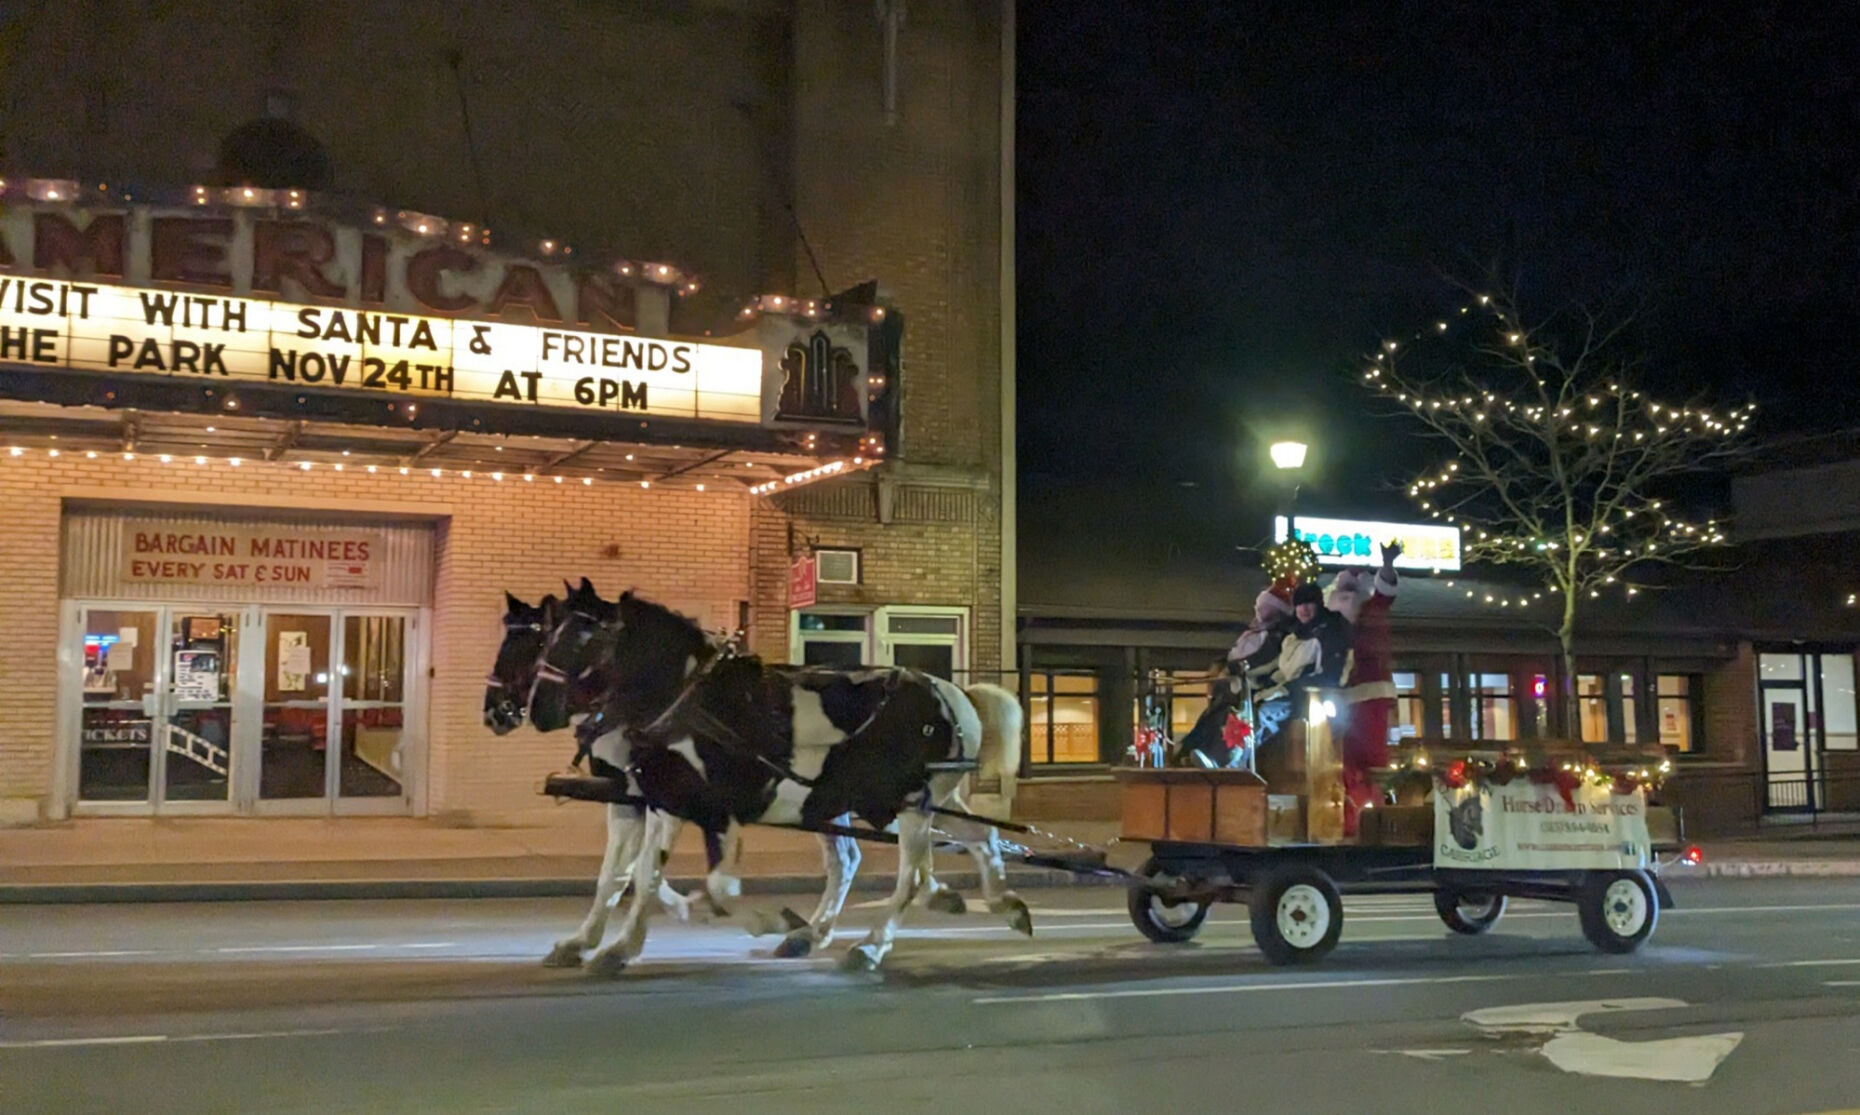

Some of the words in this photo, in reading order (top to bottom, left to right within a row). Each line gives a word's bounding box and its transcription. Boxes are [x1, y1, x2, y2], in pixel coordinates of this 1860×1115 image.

[140, 291, 247, 333] WITH
[297, 308, 438, 351] SANTA
[469, 325, 492, 356] &
[542, 331, 692, 374] FRIENDS
[109, 334, 229, 376] PARK
[270, 348, 351, 385] NOV
[364, 357, 454, 393] 24TH
[493, 370, 543, 402] AT
[574, 377, 648, 411] 6PM
[132, 559, 206, 578] EVERY
[213, 563, 251, 581] SAT
[271, 565, 311, 583] SUN
[134, 532, 236, 557] BARGAIN
[250, 537, 370, 562] MATINEES
